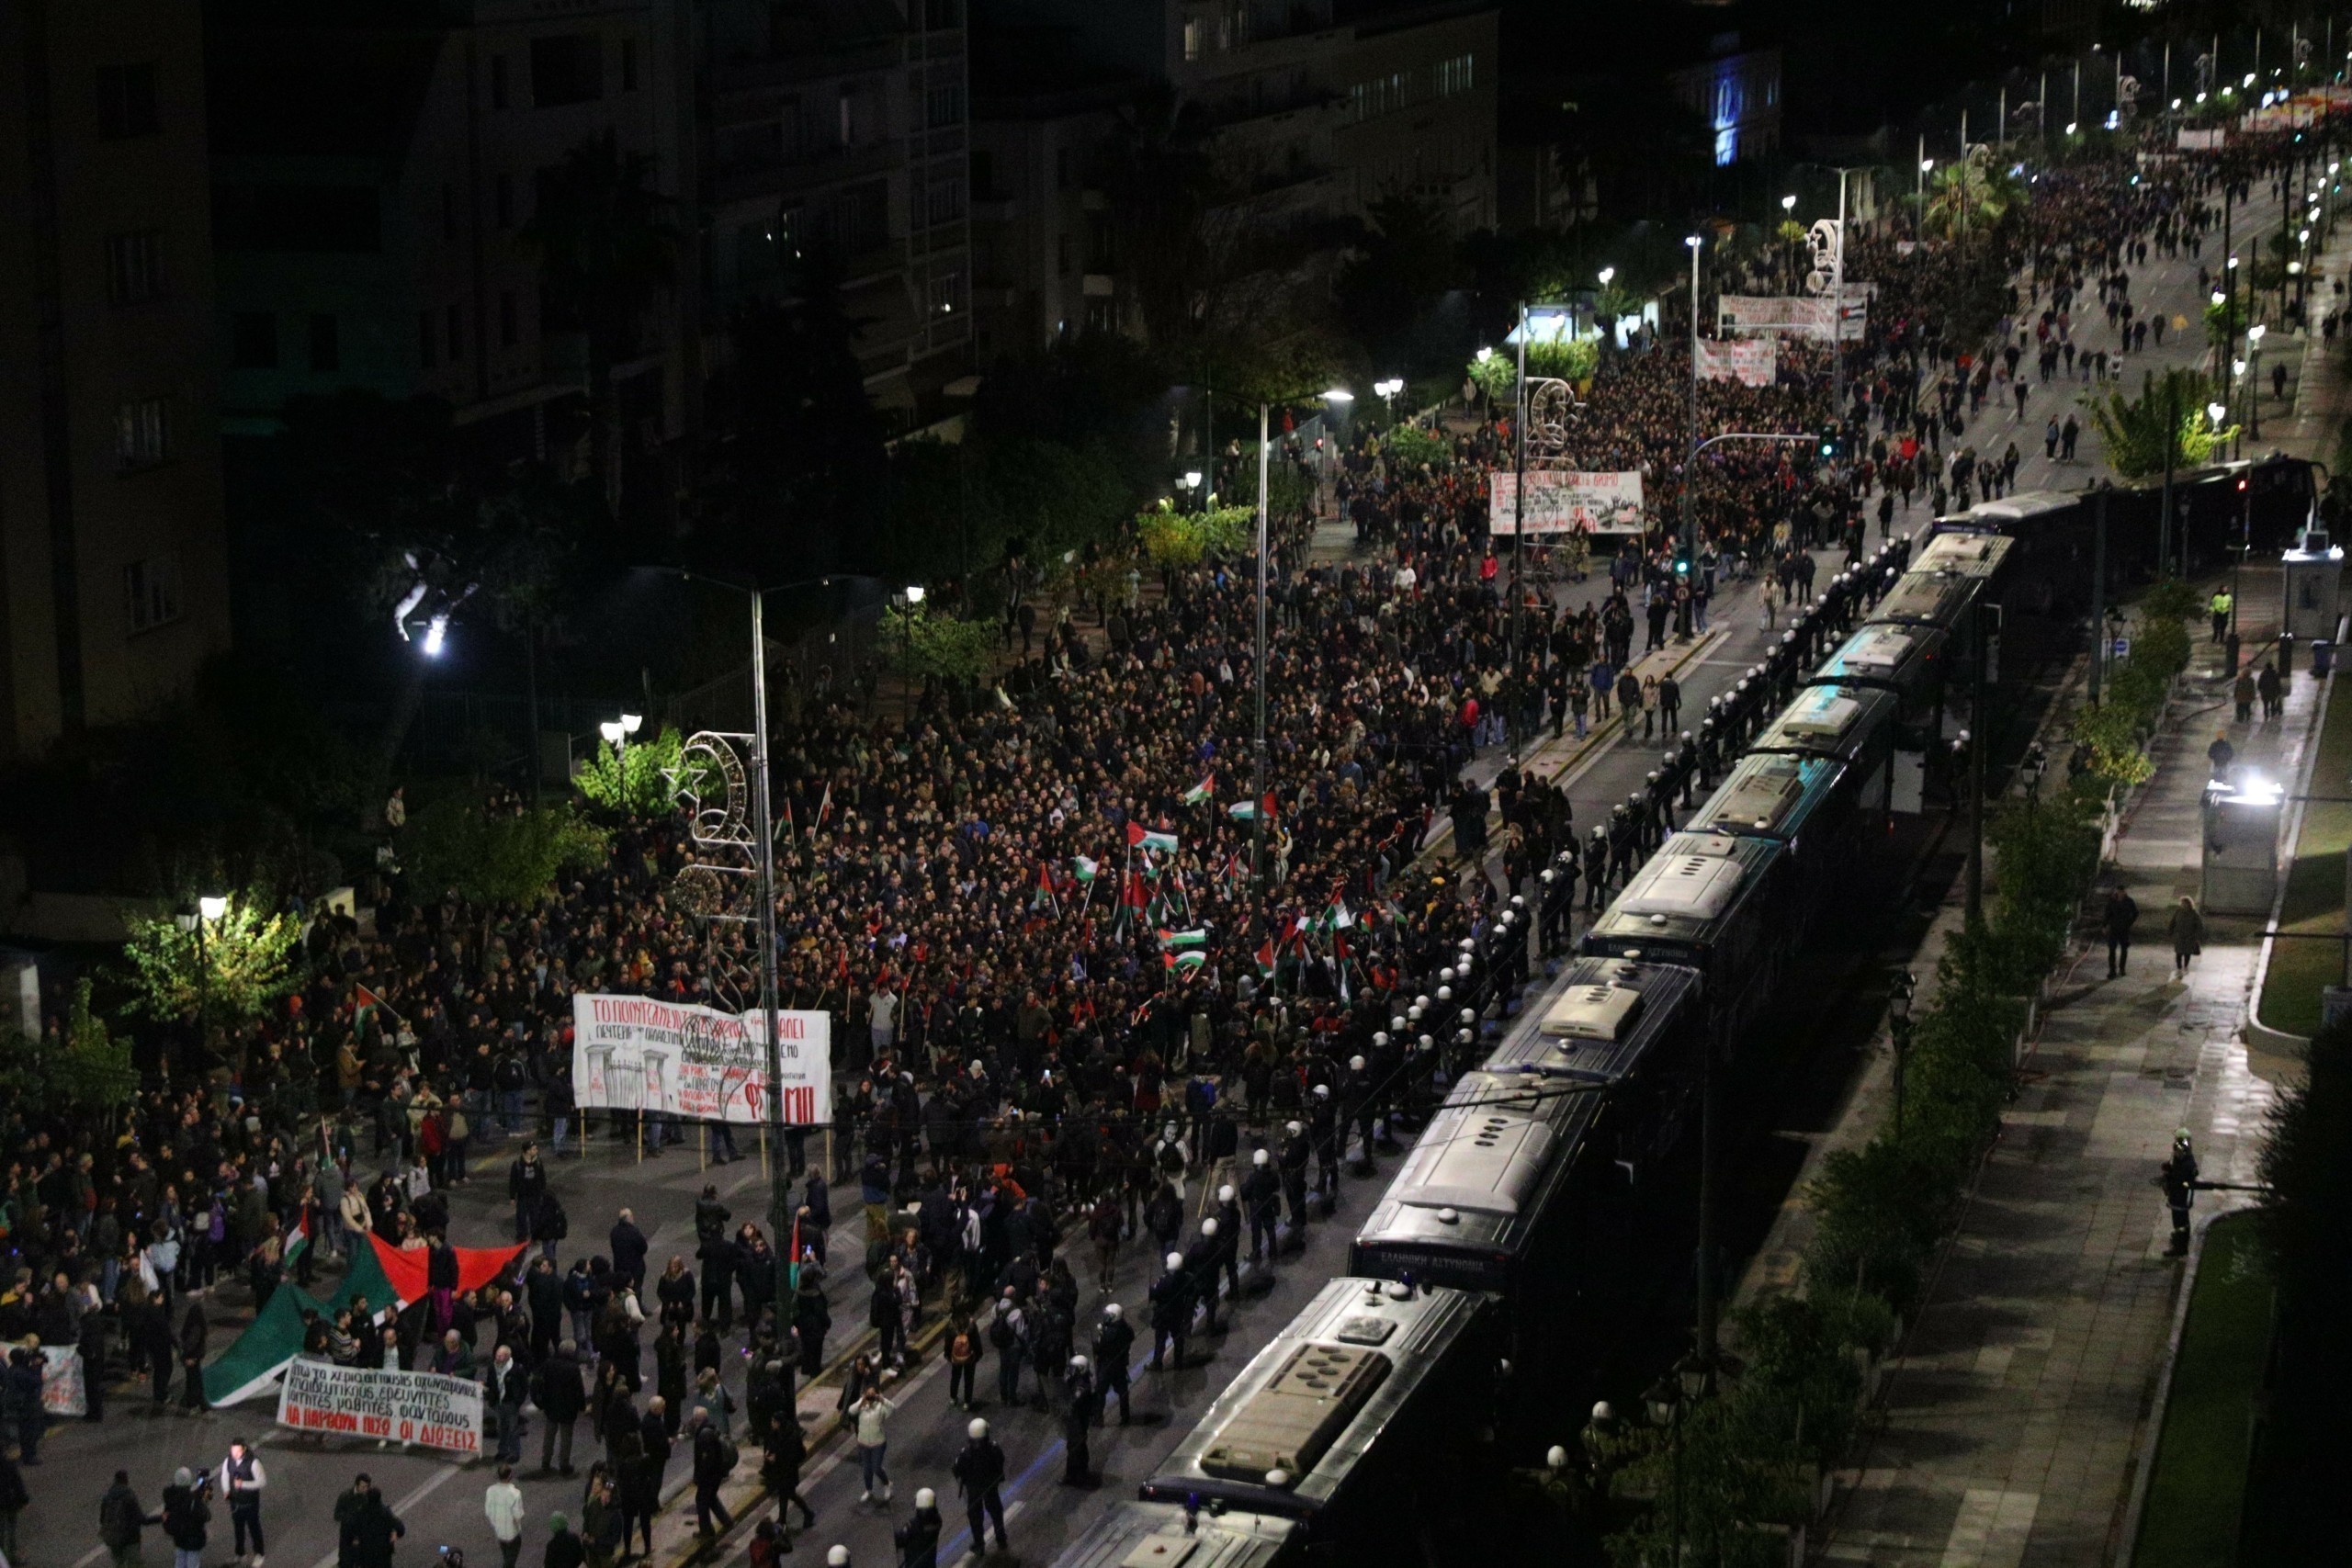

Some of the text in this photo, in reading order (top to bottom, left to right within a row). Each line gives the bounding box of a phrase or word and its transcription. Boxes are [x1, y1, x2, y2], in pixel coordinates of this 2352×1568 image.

[592, 999, 611, 1022] ΤΟ
[1381, 1252, 1485, 1272] ΕΛΛΗΝΙΚΗ ΑΣΤΥΝΟΜΙΑ
[363, 1416, 390, 1436] ΠΙΣΩ
[400, 1420, 413, 1439] ΟΙ
[420, 1423, 478, 1450] ΔΙΩΞΕΙΣ
